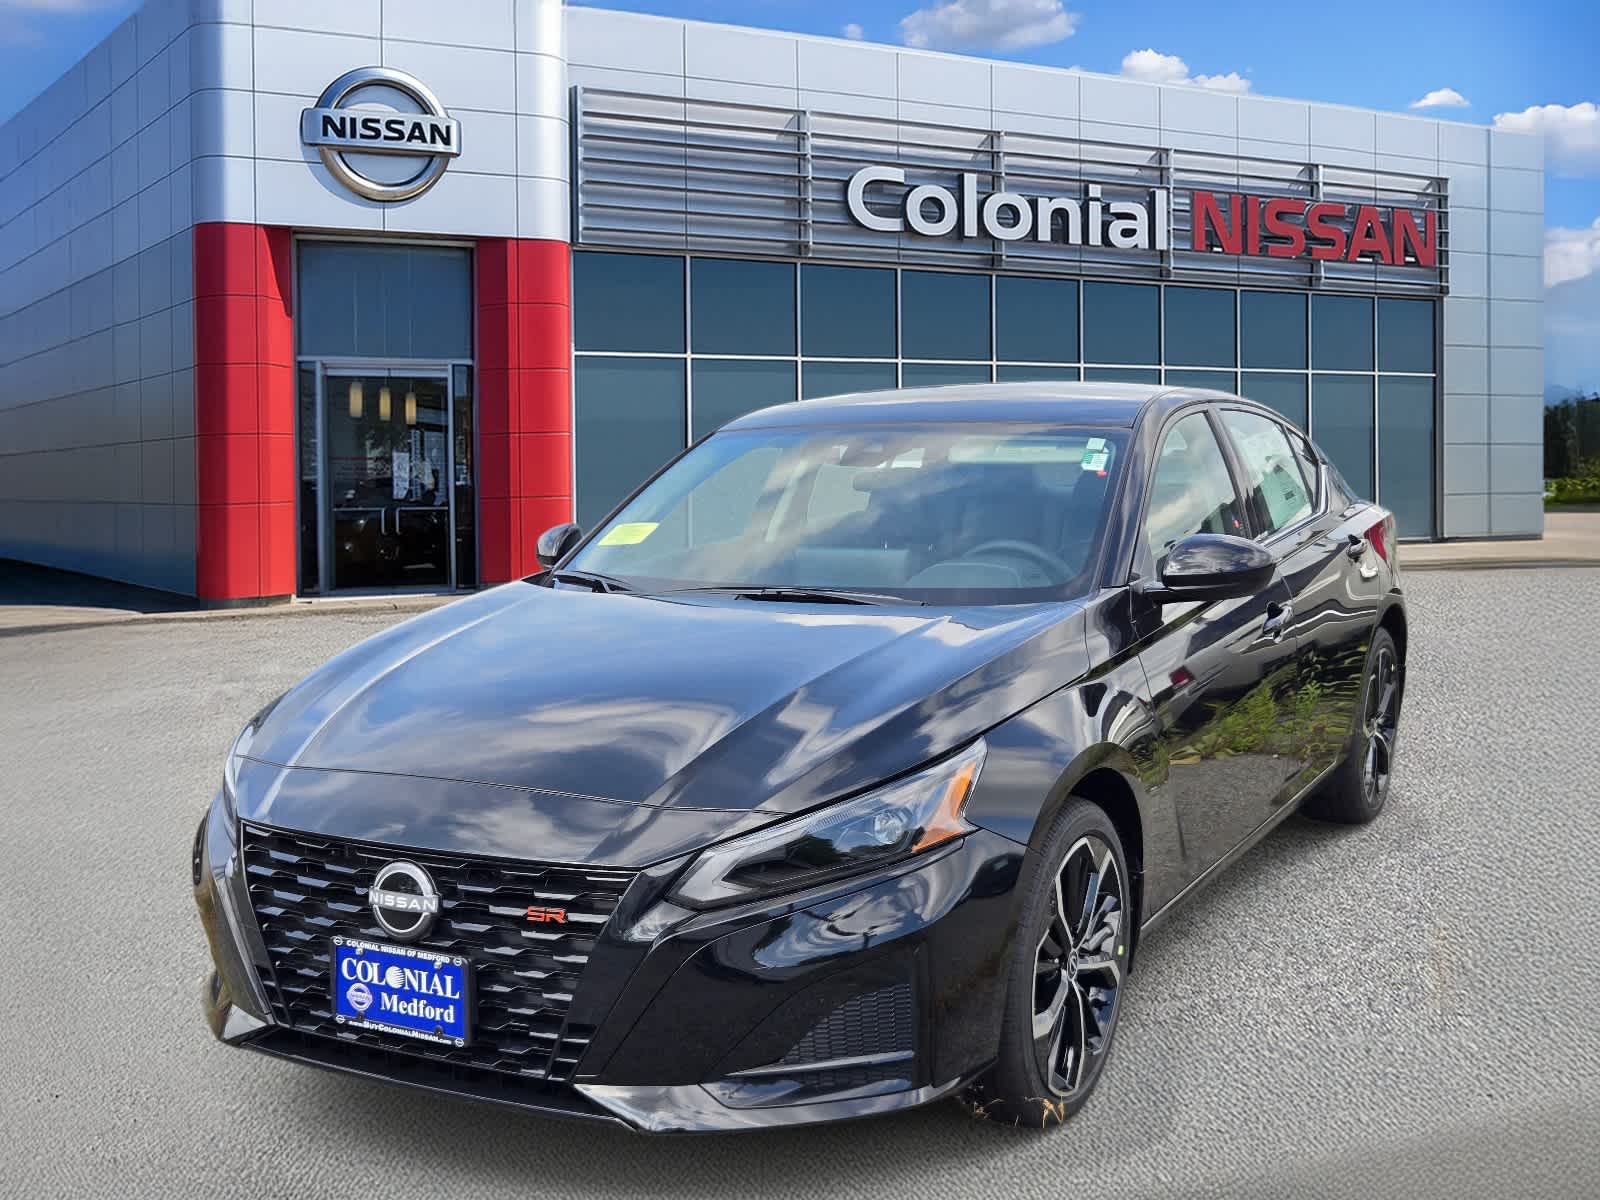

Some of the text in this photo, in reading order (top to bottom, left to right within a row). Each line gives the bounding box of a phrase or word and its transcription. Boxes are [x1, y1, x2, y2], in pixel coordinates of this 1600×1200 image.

[322, 115, 451, 146] NISSAN
[846, 166, 1437, 268] Colonial NISSAN
[369, 892, 437, 912] NISSAN
[527, 906, 568, 924] SR
[346, 939, 450, 963] COLONIAL NISSAN OF MEDFORD
[380, 991, 455, 1024] Medford
